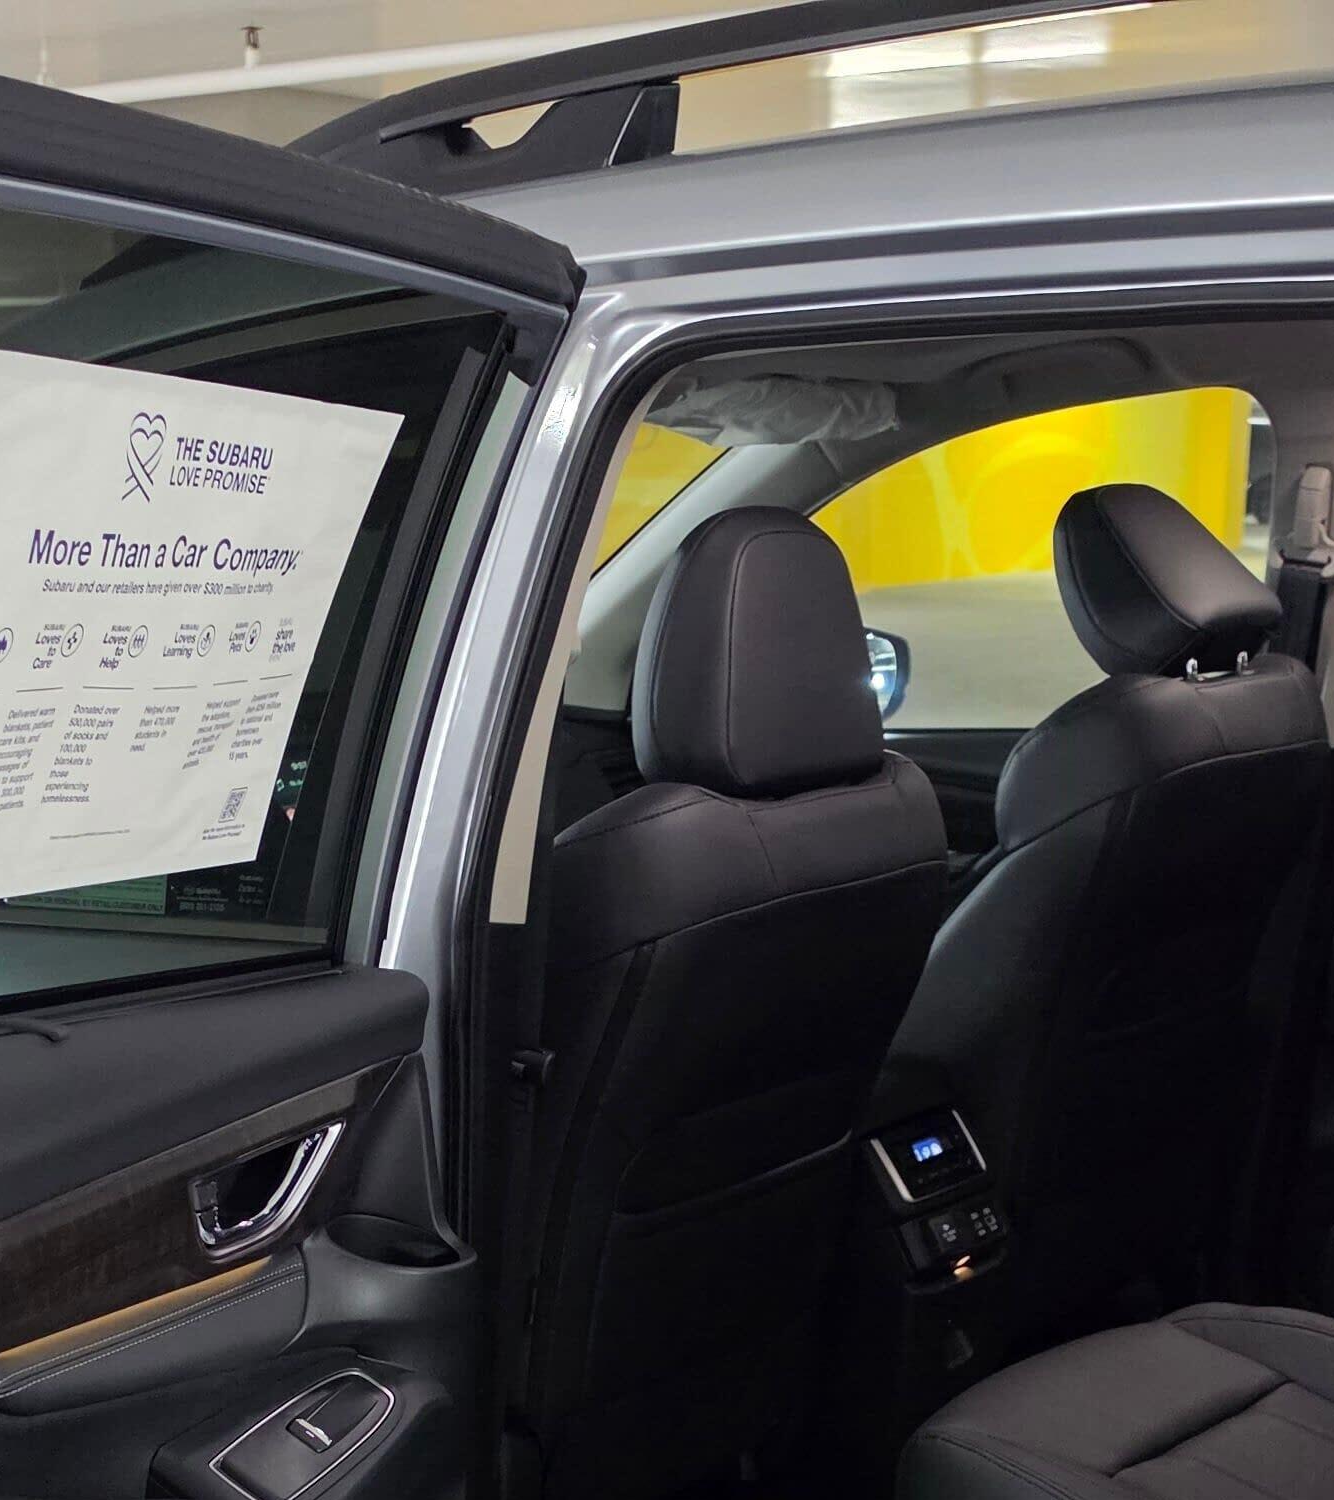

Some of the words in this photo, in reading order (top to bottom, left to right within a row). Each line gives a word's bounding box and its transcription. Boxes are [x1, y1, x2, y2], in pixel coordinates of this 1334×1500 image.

[175, 437, 204, 462] THE
[206, 440, 274, 471] SUBARU
[169, 466, 202, 488] LOVE
[202, 469, 268, 495] PROMISE
[28, 528, 92, 567] More
[100, 533, 151, 568] Than
[154, 543, 167, 569] a
[171, 535, 209, 569] Car
[42, 578, 75, 593] Subaru
[77, 579, 95, 593] and
[95, 582, 112, 593] our
[112, 581, 145, 595] retailers
[145, 581, 163, 594] have
[163, 582, 183, 597] given
[183, 583, 203, 594] over
[203, 581, 224, 596] $300
[43, 623, 67, 632] SUBARU
[35, 632, 61, 645] Loves
[102, 632, 128, 646] Loves
[174, 632, 197, 644] Loves
[47, 646, 57, 657] to
[114, 646, 124, 657] to
[162, 645, 193, 659] Learning
[32, 657, 53, 670] Care
[98, 657, 120, 671] Help
[73, 704, 105, 715] Donated
[104, 706, 121, 715] over
[63, 731, 73, 740] of
[54, 756, 84, 766] blankets
